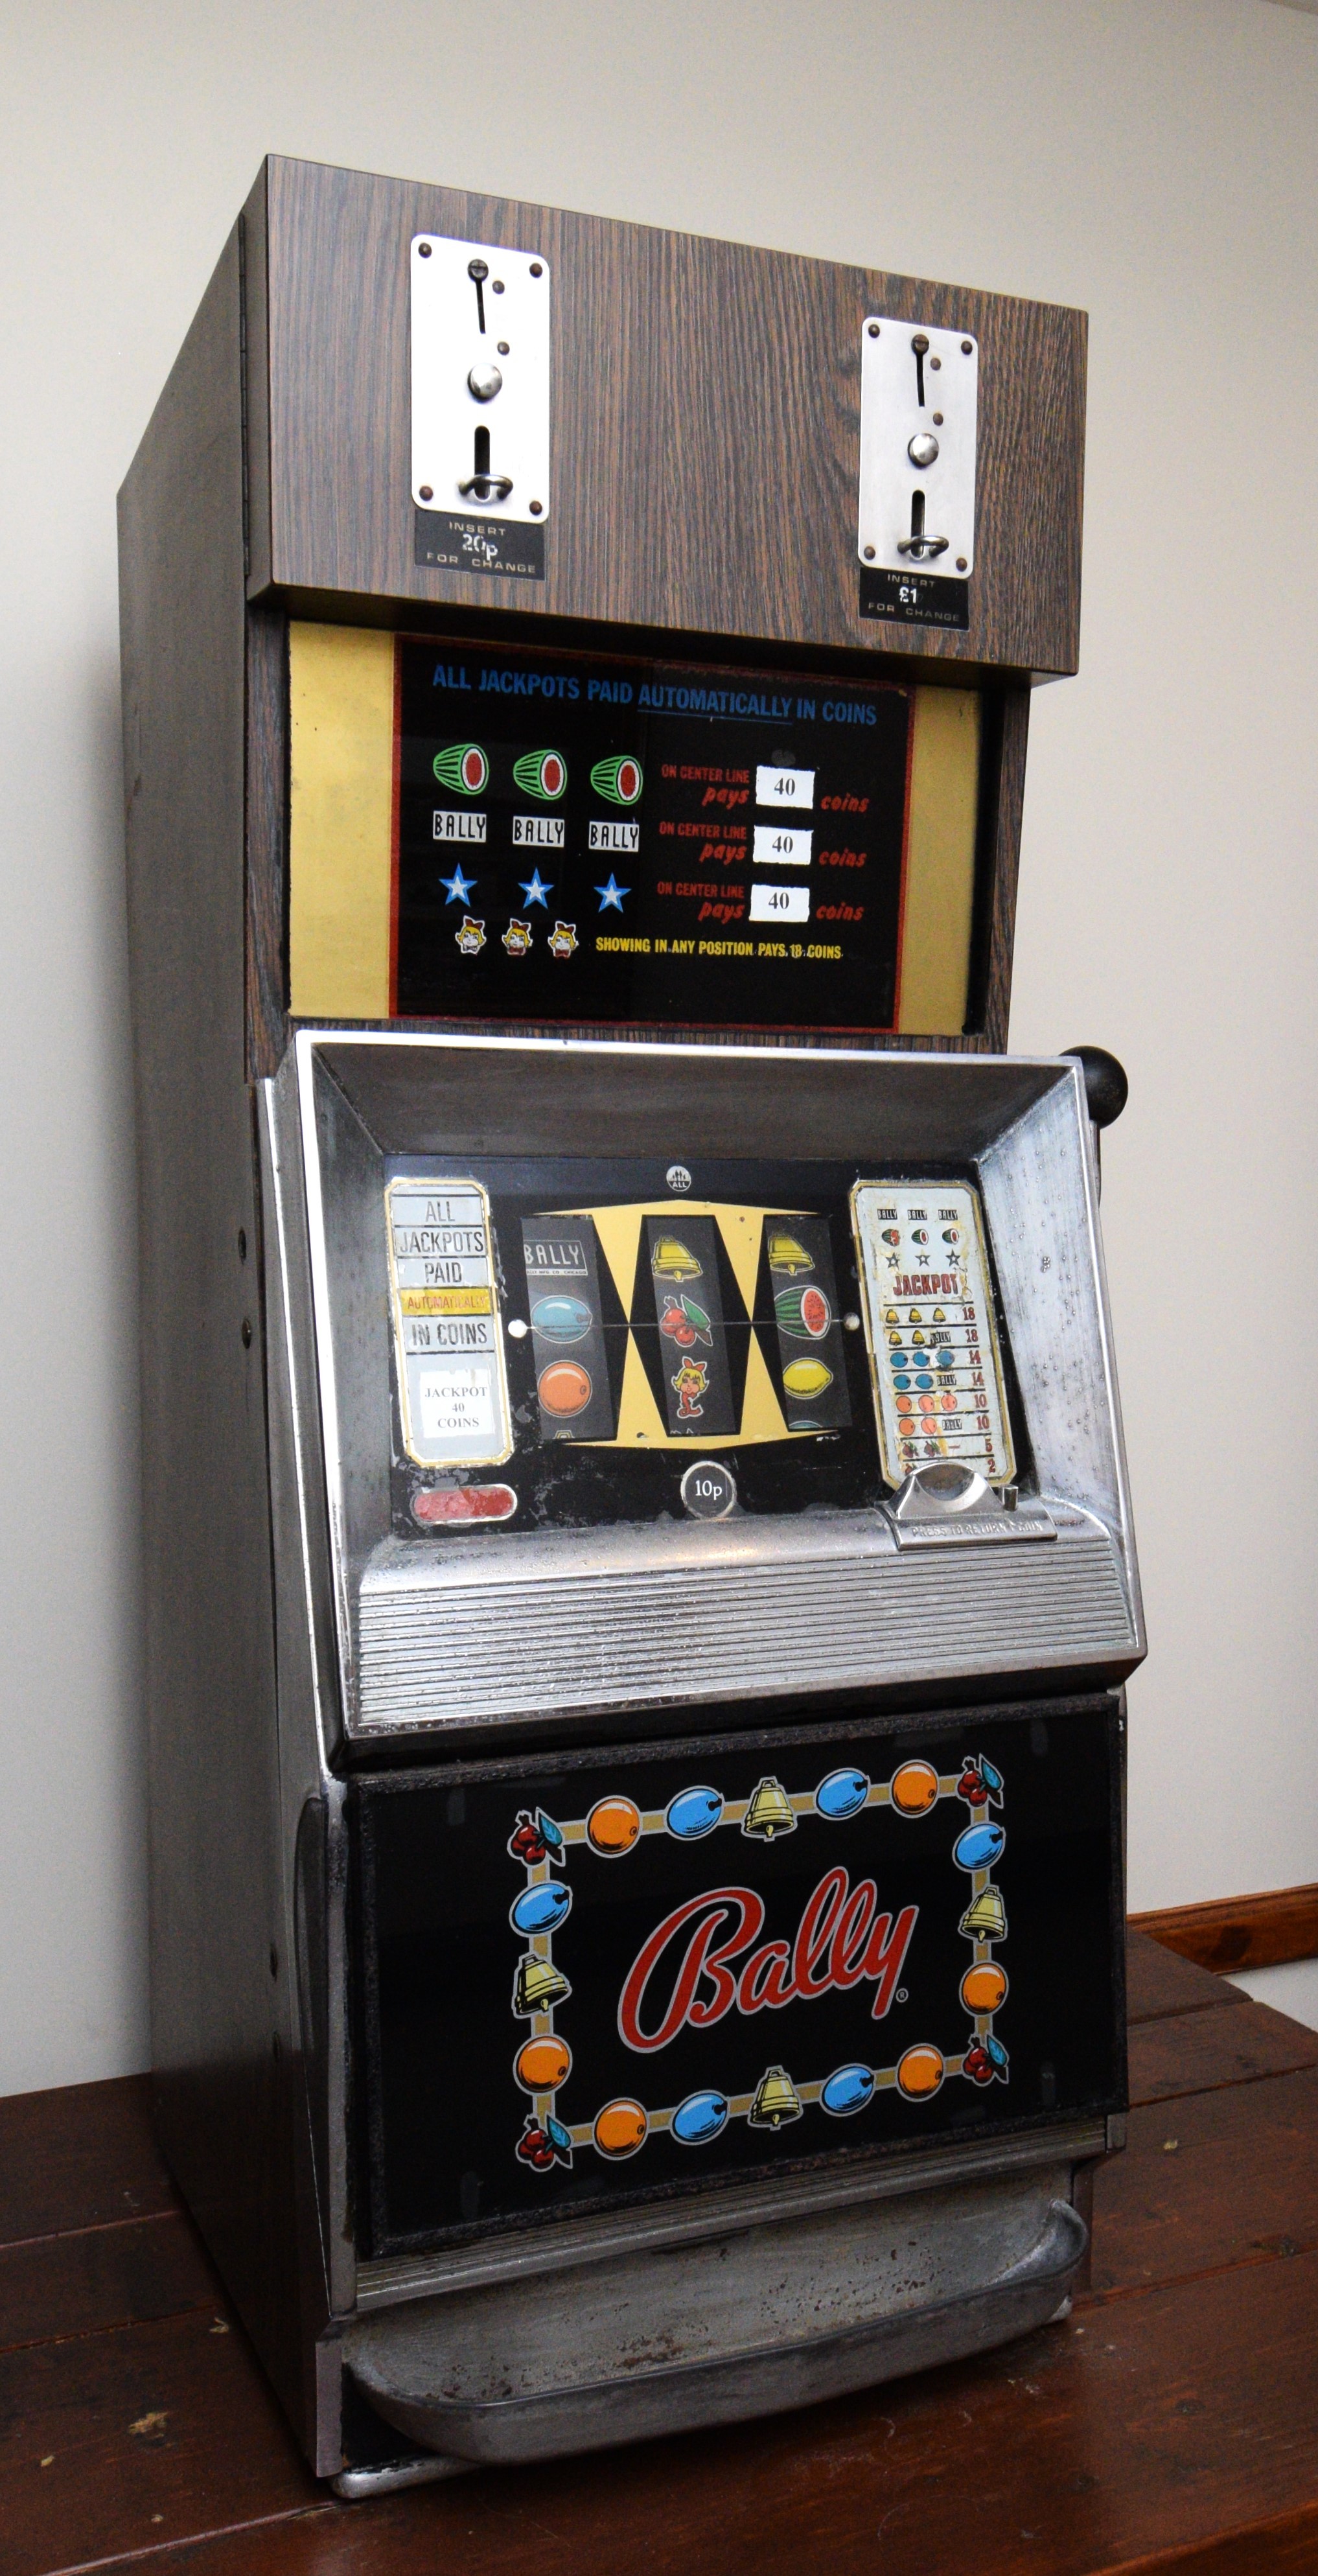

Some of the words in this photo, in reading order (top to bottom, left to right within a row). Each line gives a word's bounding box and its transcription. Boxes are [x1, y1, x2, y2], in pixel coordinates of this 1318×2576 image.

[449, 522, 505, 536] INSERT
[462, 533, 498, 561] 20p
[426, 552, 458, 564] FOR
[472, 558, 536, 574] CHANGE
[887, 574, 935, 588] INSERT
[899, 586, 917, 603] £1
[868, 602, 895, 612] FOR
[906, 607, 960, 621] CHANGE
[432, 664, 471, 690] ALL
[478, 669, 579, 700] JACKPOTS
[588, 679, 633, 704] PAID
[638, 684, 792, 718] AUTOMATICALLY
[797, 699, 816, 719] IN
[822, 701, 877, 725] COINS
[662, 764, 676, 778] ON
[680, 765, 722, 782] CENTER
[725, 769, 750, 783] LINE
[702, 786, 750, 809] pays
[774, 778, 796, 796] 40
[820, 792, 870, 813] coins
[435, 813, 485, 840] BALLY
[514, 819, 563, 844] BALLY
[590, 824, 638, 849] BALLY
[659, 821, 675, 835] ON
[678, 822, 719, 839] CENTER
[723, 826, 746, 840] LINE
[699, 843, 746, 866] pays
[772, 835, 793, 853] 40
[818, 848, 867, 868] coins
[657, 880, 673, 895] ON
[676, 882, 717, 898] CENTER
[721, 884, 745, 898] LINE
[698, 901, 745, 924] pays
[768, 892, 790, 910] 40
[816, 901, 864, 922] coins
[595, 936, 651, 953] SHOWING
[654, 939, 667, 953] IN
[672, 940, 695, 955] ANY
[699, 941, 754, 957] POSITION
[425, 1201, 455, 1222] ALL
[877, 1209, 897, 1219] BALLY
[908, 1210, 927, 1220] BALLY
[938, 1210, 958, 1220] BALLY
[400, 1231, 483, 1253] JACKPOTS
[523, 1244, 579, 1265] BALLY
[424, 1262, 462, 1283] PAID
[892, 1273, 958, 1296] JACKPOT
[408, 1295, 485, 1309] AUTOMATICALLY
[962, 1307, 976, 1321] 18
[411, 1323, 430, 1346] IN
[437, 1323, 487, 1345] COINS
[965, 1329, 978, 1343] 18
[969, 1350, 982, 1365] 14
[971, 1371, 985, 1386] 14
[424, 1387, 487, 1398] JACKPOT
[974, 1393, 987, 1408] 10
[452, 1402, 465, 1413] 40
[437, 1417, 479, 1428] COINS
[977, 1414, 989, 1431] 10
[984, 1438, 993, 1452] 5
[987, 1458, 996, 1473] 2
[695, 1479, 723, 1500] 10p
[912, 1526, 947, 1537] PRESS
[951, 1524, 963, 1535] TO
[965, 1522, 1006, 1535] RETURN
[617, 1866, 919, 2053] Bally
